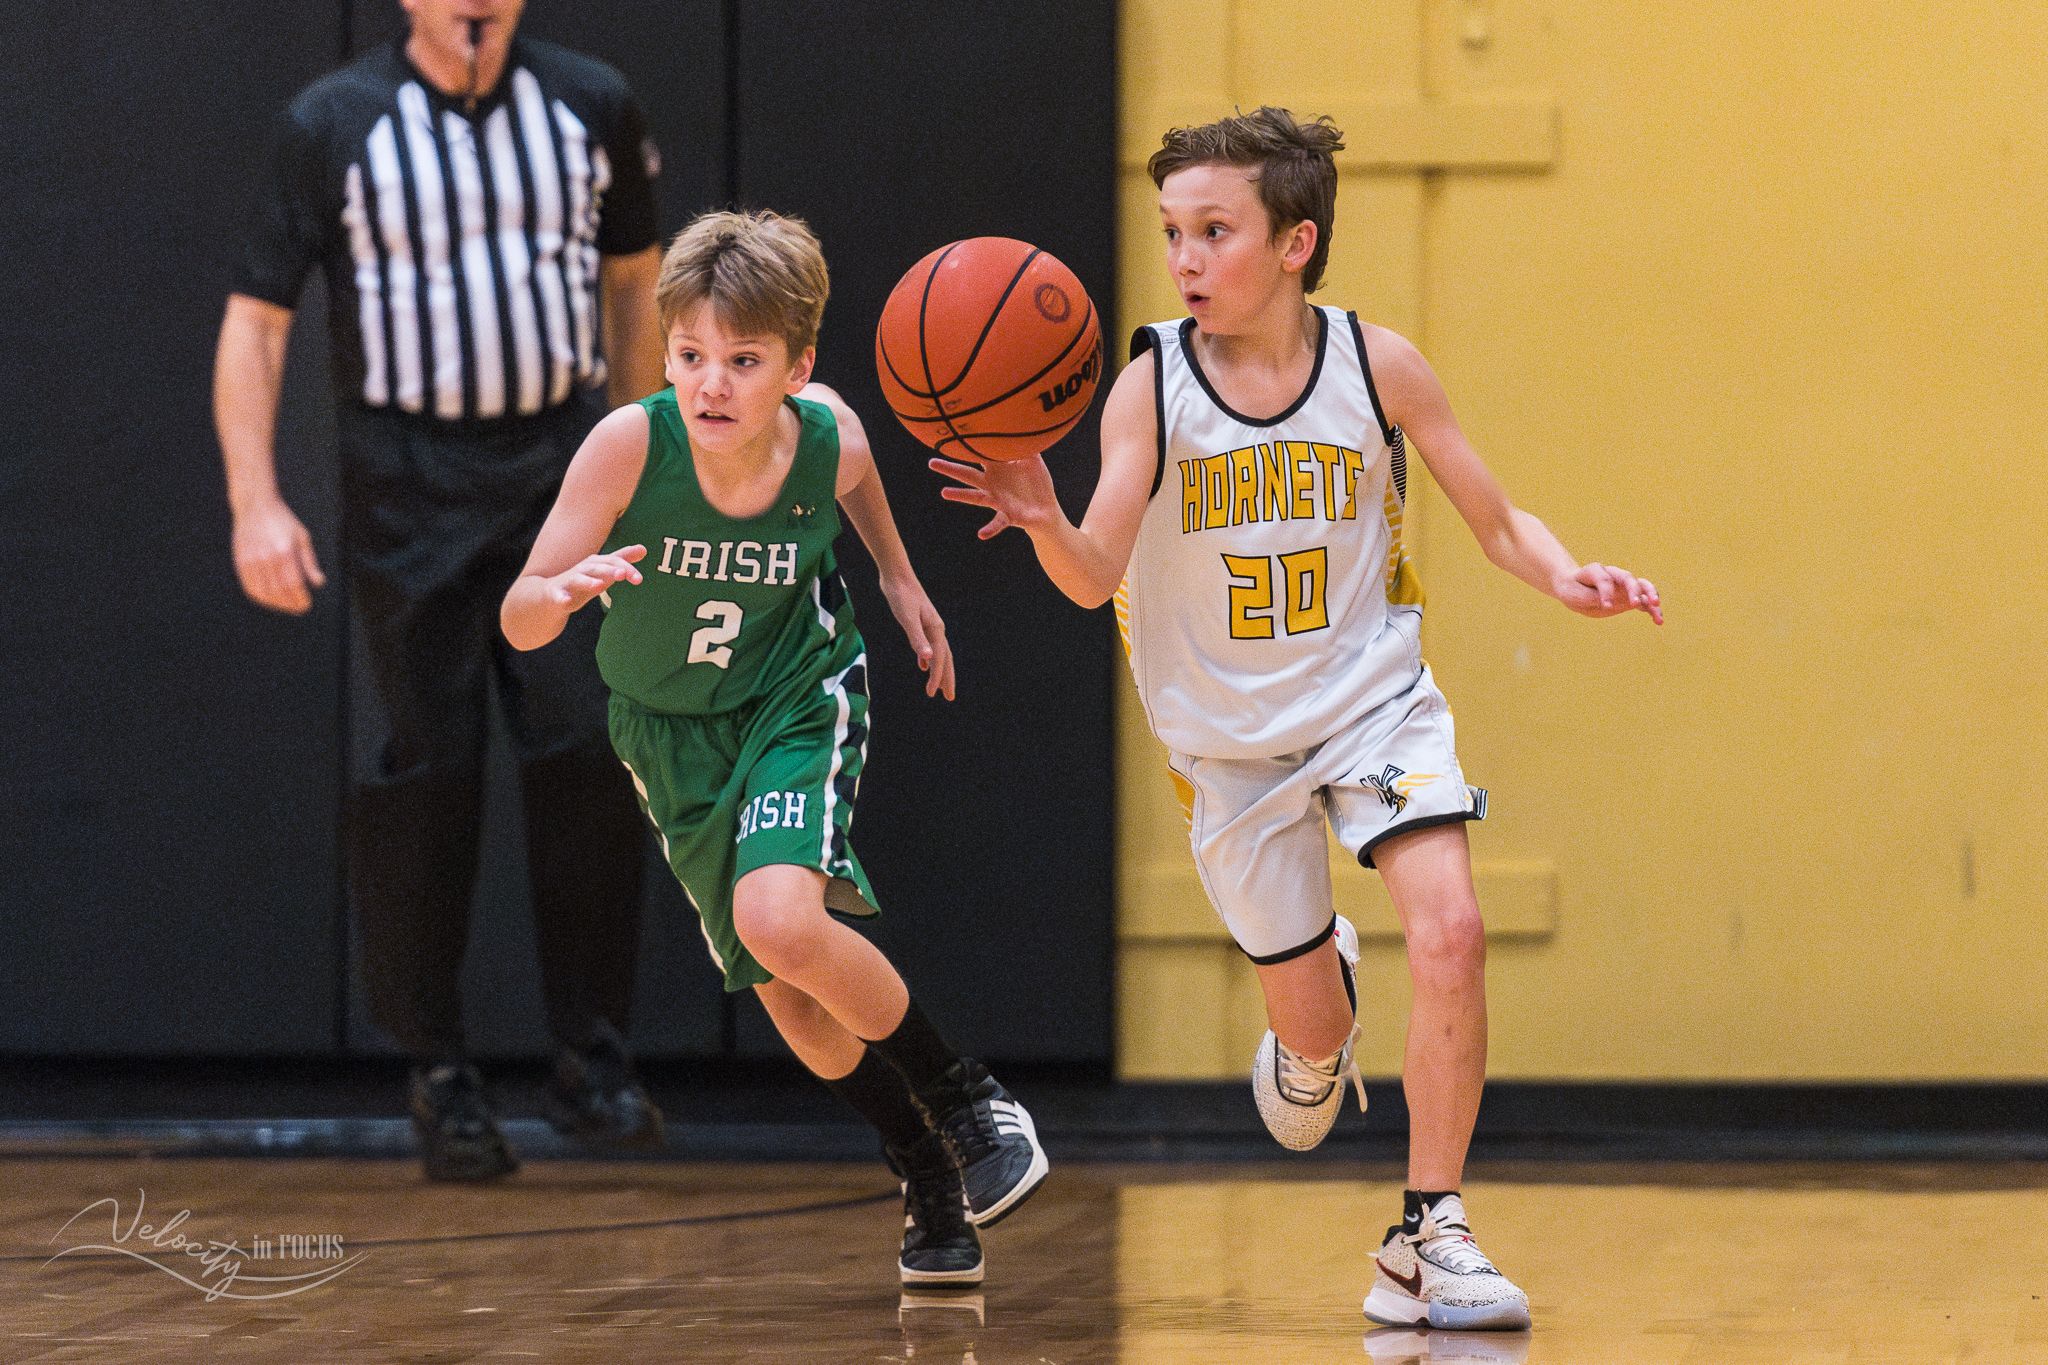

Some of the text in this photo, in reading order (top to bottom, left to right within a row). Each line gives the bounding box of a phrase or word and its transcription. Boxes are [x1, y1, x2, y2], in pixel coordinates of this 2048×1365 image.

[1178, 440, 1364, 534] HORNETS
[656, 536, 799, 586] IRISH
[1220, 545, 1331, 640] 20
[686, 599, 744, 670] 2
[735, 790, 807, 844] RISH
